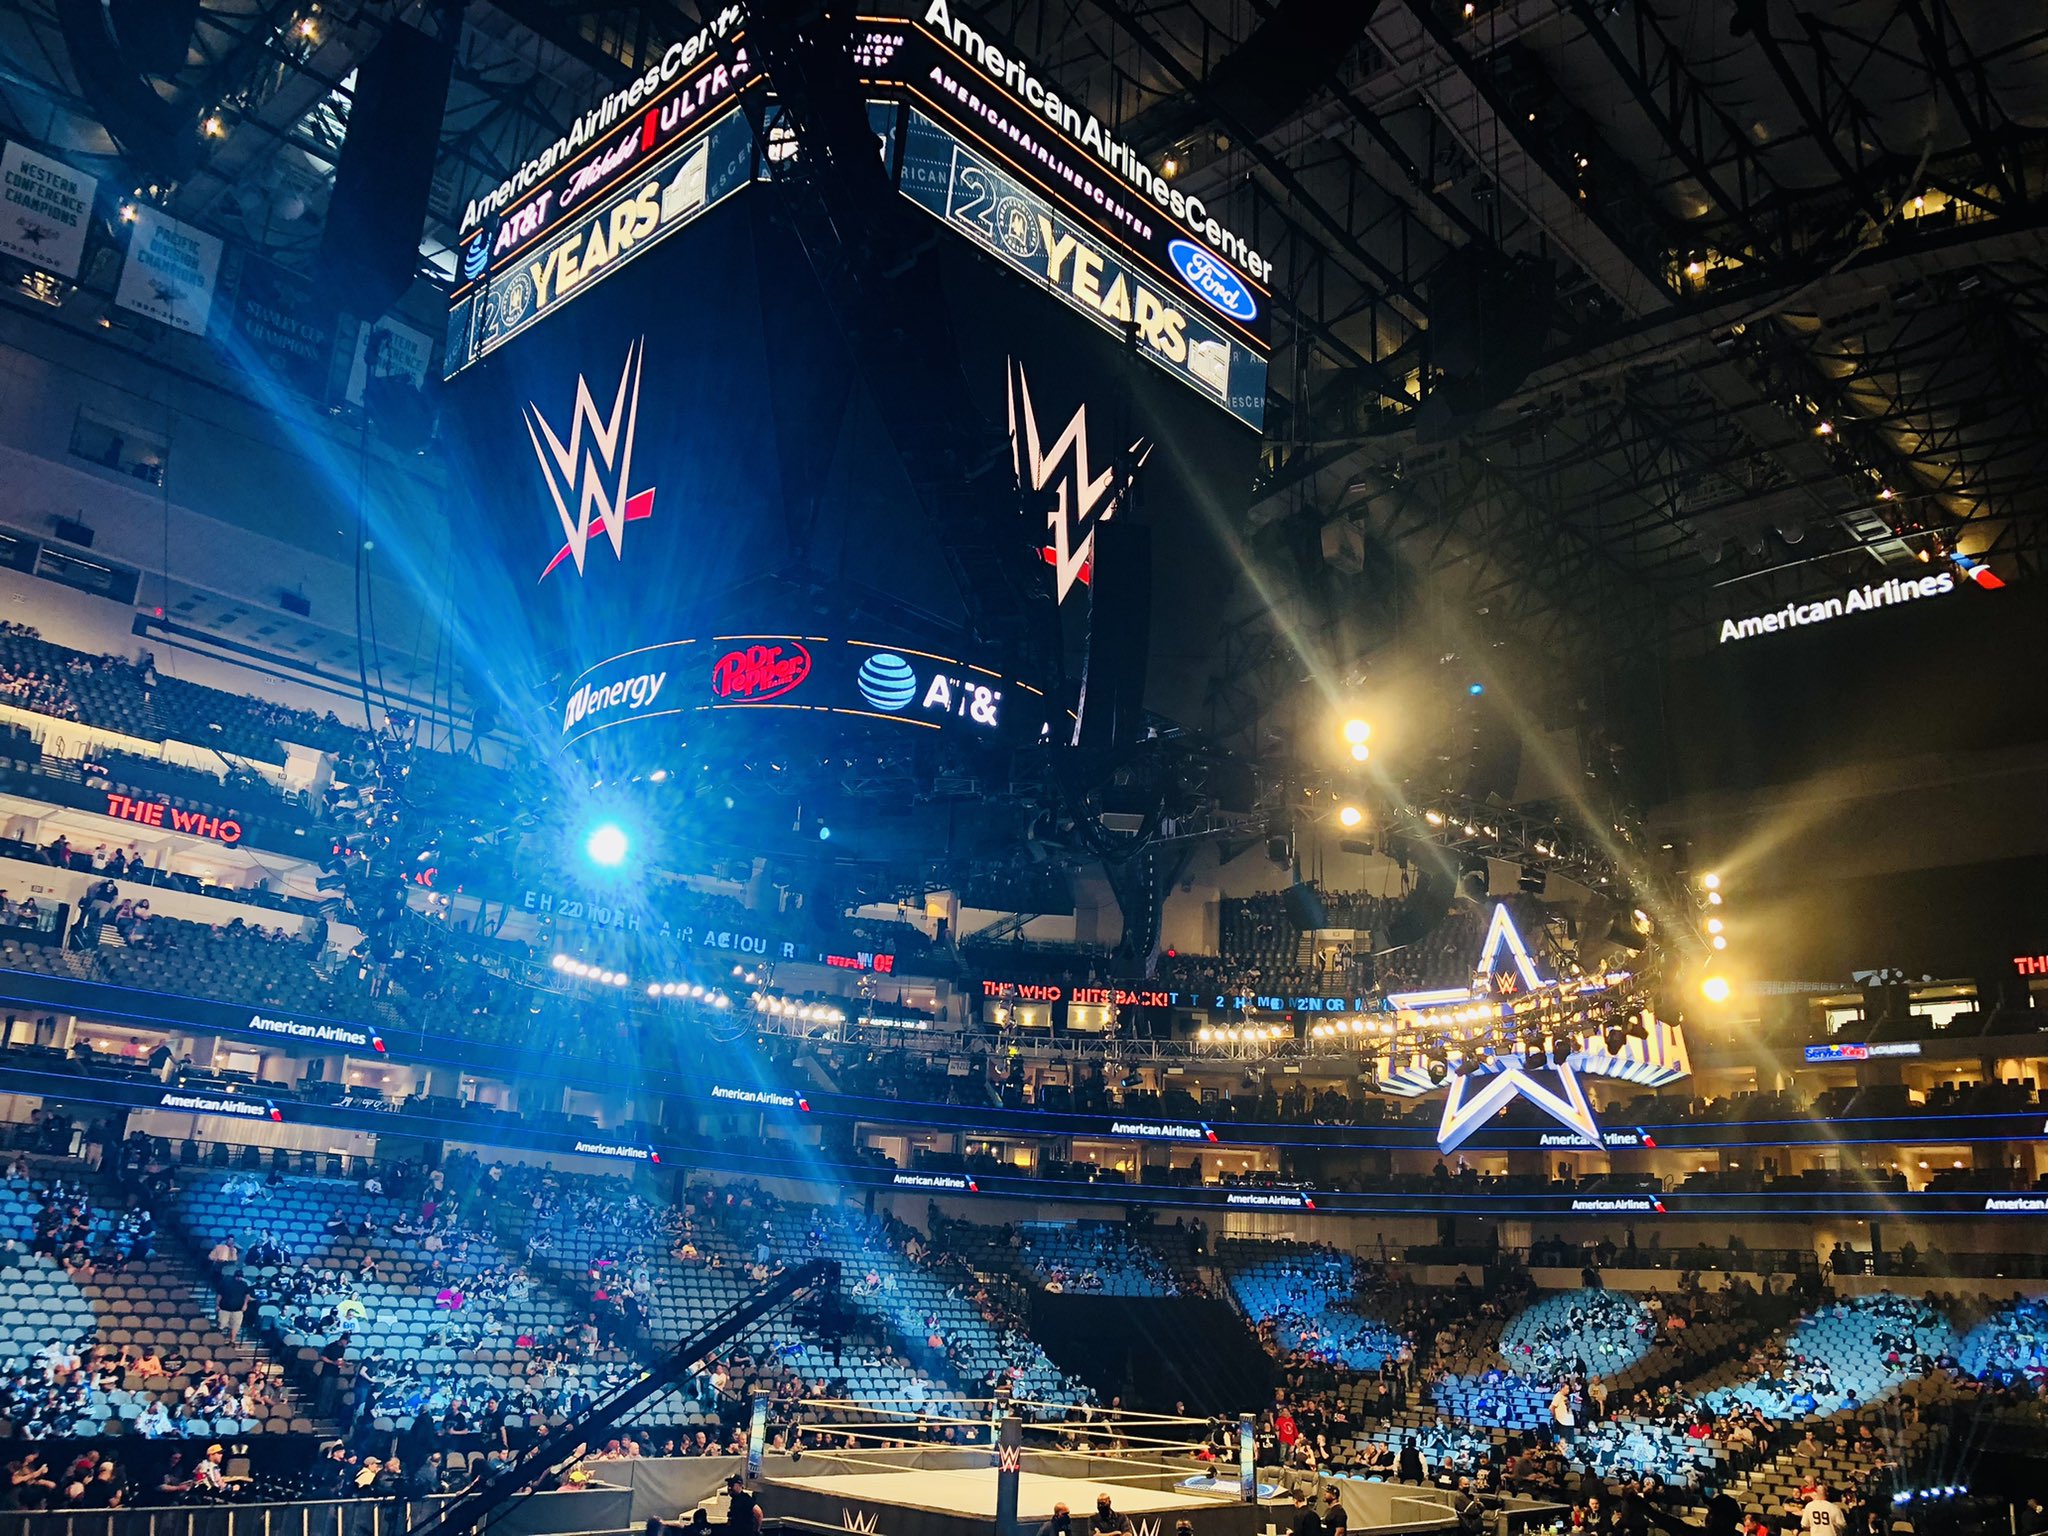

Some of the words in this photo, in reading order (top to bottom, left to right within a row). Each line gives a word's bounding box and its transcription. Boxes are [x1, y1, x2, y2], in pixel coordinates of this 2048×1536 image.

[459, 1, 750, 236] AmericanAirlinesCente
[5, 170, 87, 214] CONFERENCE
[20, 161, 78, 195] WESTERN
[5, 188, 78, 228] CHAMPIONS
[493, 189, 553, 256] AT&T
[530, 182, 660, 310] YEARS
[1038, 213, 1187, 363] YEARS
[1186, 253, 1240, 310] Ford
[1719, 596, 1843, 644] American
[1844, 572, 1954, 614] Airlines
[746, 645, 782, 671] Dr
[713, 651, 803, 697] Pepper
[107, 793, 165, 826] THE
[170, 808, 242, 843] WHO
[2013, 955, 2048, 975] TH
[1018, 984, 1061, 1001] WHO
[1072, 988, 1110, 1004] HITS
[1115, 990, 1169, 1007] BACK!
[249, 1015, 315, 1037] American
[315, 1025, 366, 1045] Airlines
[160, 1093, 220, 1111] American
[219, 1100, 265, 1115] Airlines
[711, 1085, 756, 1102] American
[756, 1091, 794, 1107] Airlines
[1111, 1122, 1161, 1136] American
[1161, 1125, 1201, 1138] Airlines
[574, 1141, 616, 1155] American
[615, 1145, 648, 1159] Airlines
[893, 1174, 933, 1186] American
[932, 1177, 965, 1188] Airlines
[1226, 1193, 1268, 1205] American
[1268, 1195, 1301, 1206] Airlines
[1571, 1199, 1615, 1210] American
[1614, 1199, 1651, 1210] Airlines
[1985, 1198, 2045, 1210] American
[1812, 1511, 1830, 1525] 99
